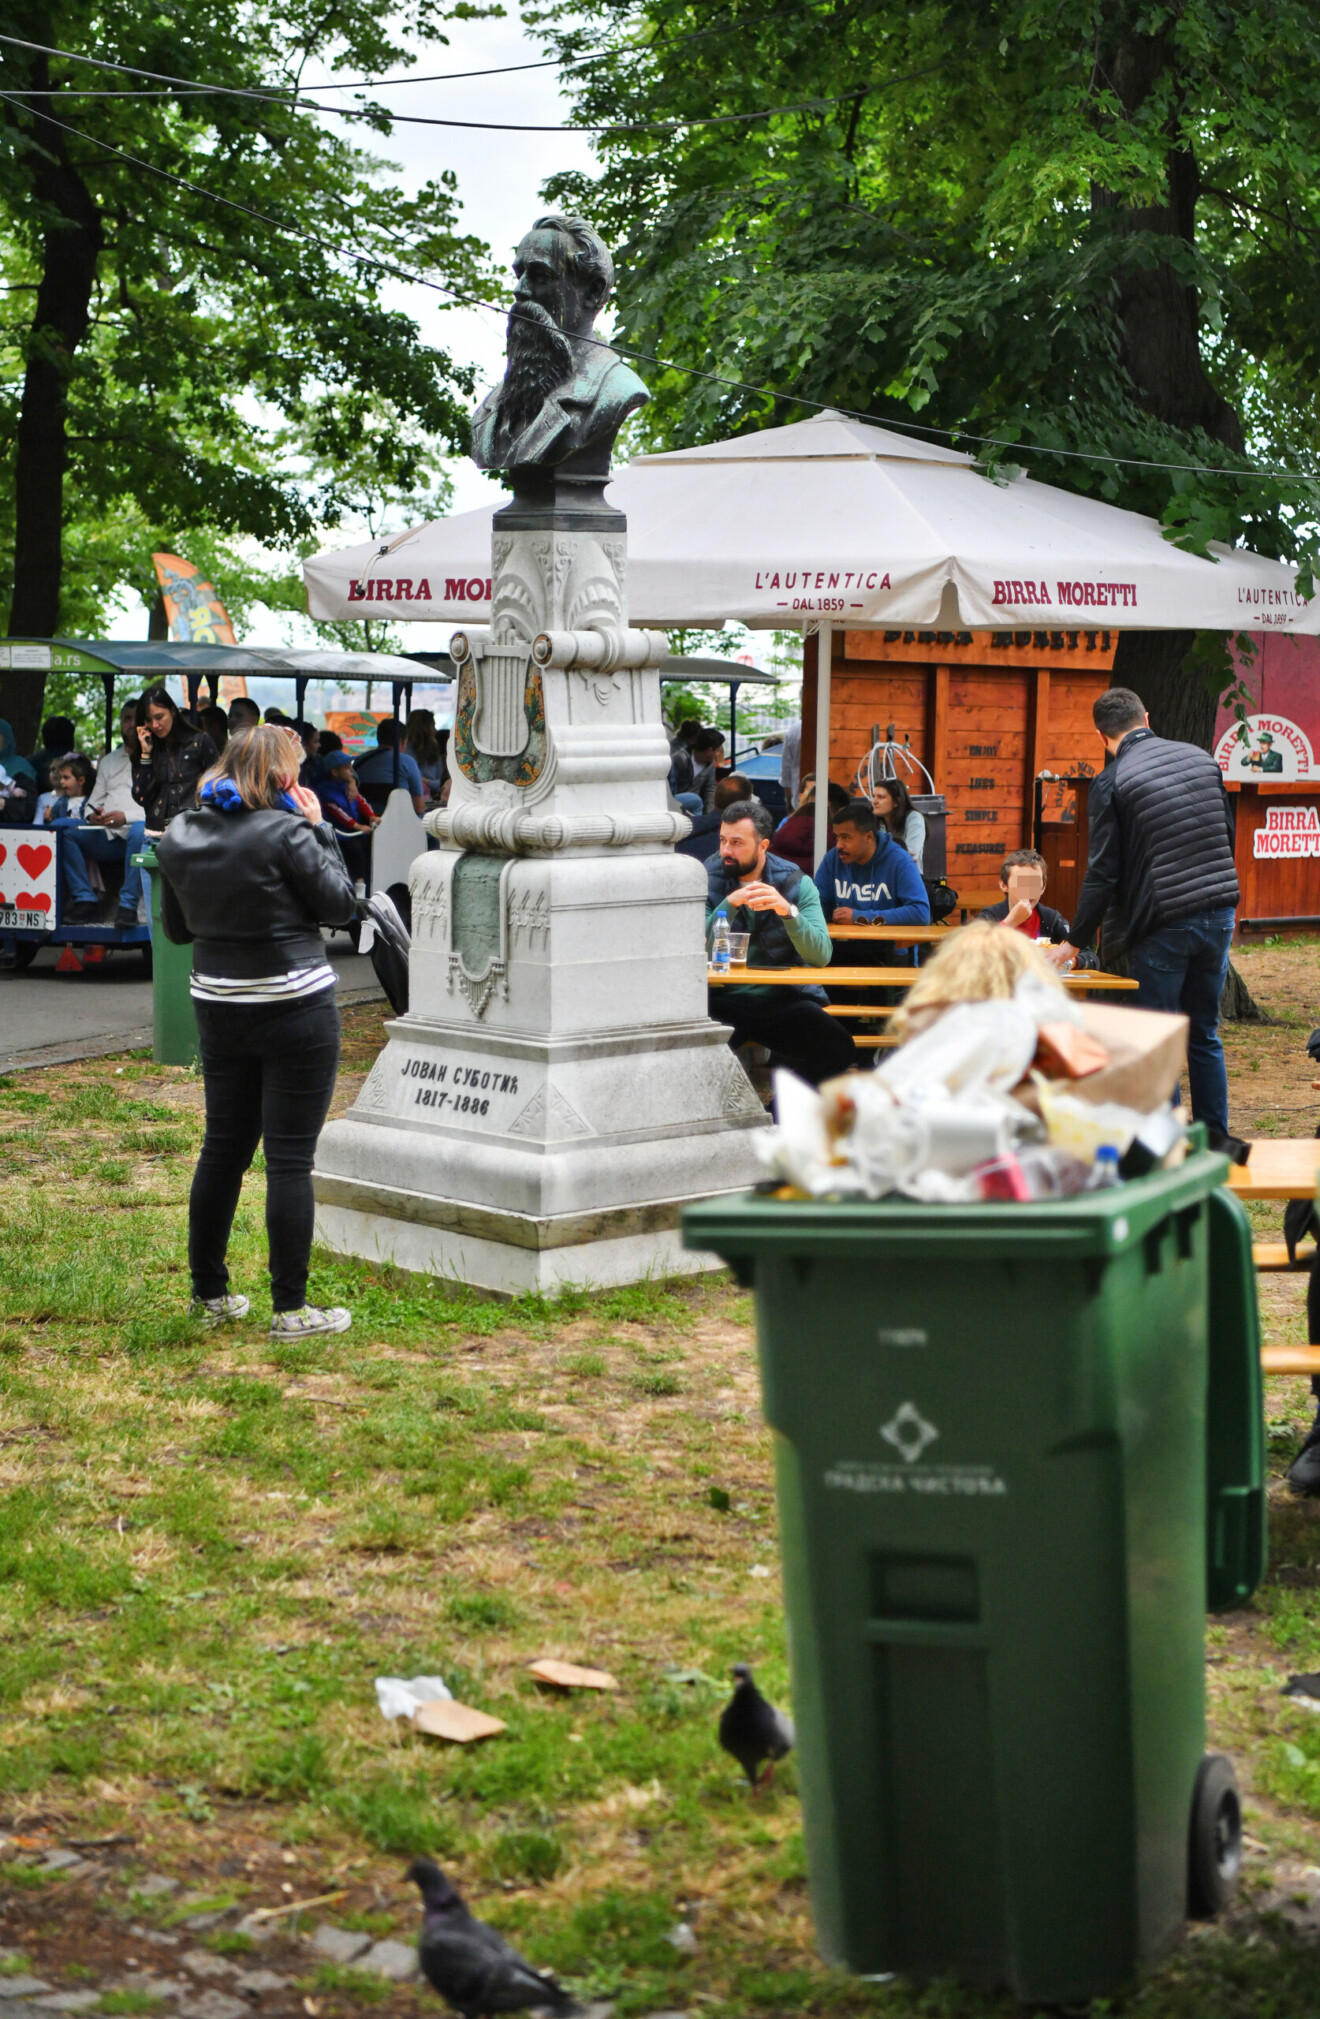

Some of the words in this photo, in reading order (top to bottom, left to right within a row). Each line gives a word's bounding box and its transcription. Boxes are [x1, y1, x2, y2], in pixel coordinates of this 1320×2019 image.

[348, 579, 432, 601] BIRRA
[755, 572, 892, 590] L'AUTENTICA
[792, 598, 815, 610] DAL
[817, 599, 845, 611] 1859
[991, 580, 1052, 605] BIRRA
[1057, 581, 1138, 607] MORETTI
[1257, 719, 1309, 774] MORETTI
[1268, 811, 1317, 831] BIRRA
[834, 878, 892, 902] NASA
[26, 912, 40, 927] NS
[401, 1059, 448, 1083] ЈОВАН
[452, 1066, 519, 1095] СУБОТИЋ
[414, 1088, 490, 1116] 1817-1886
